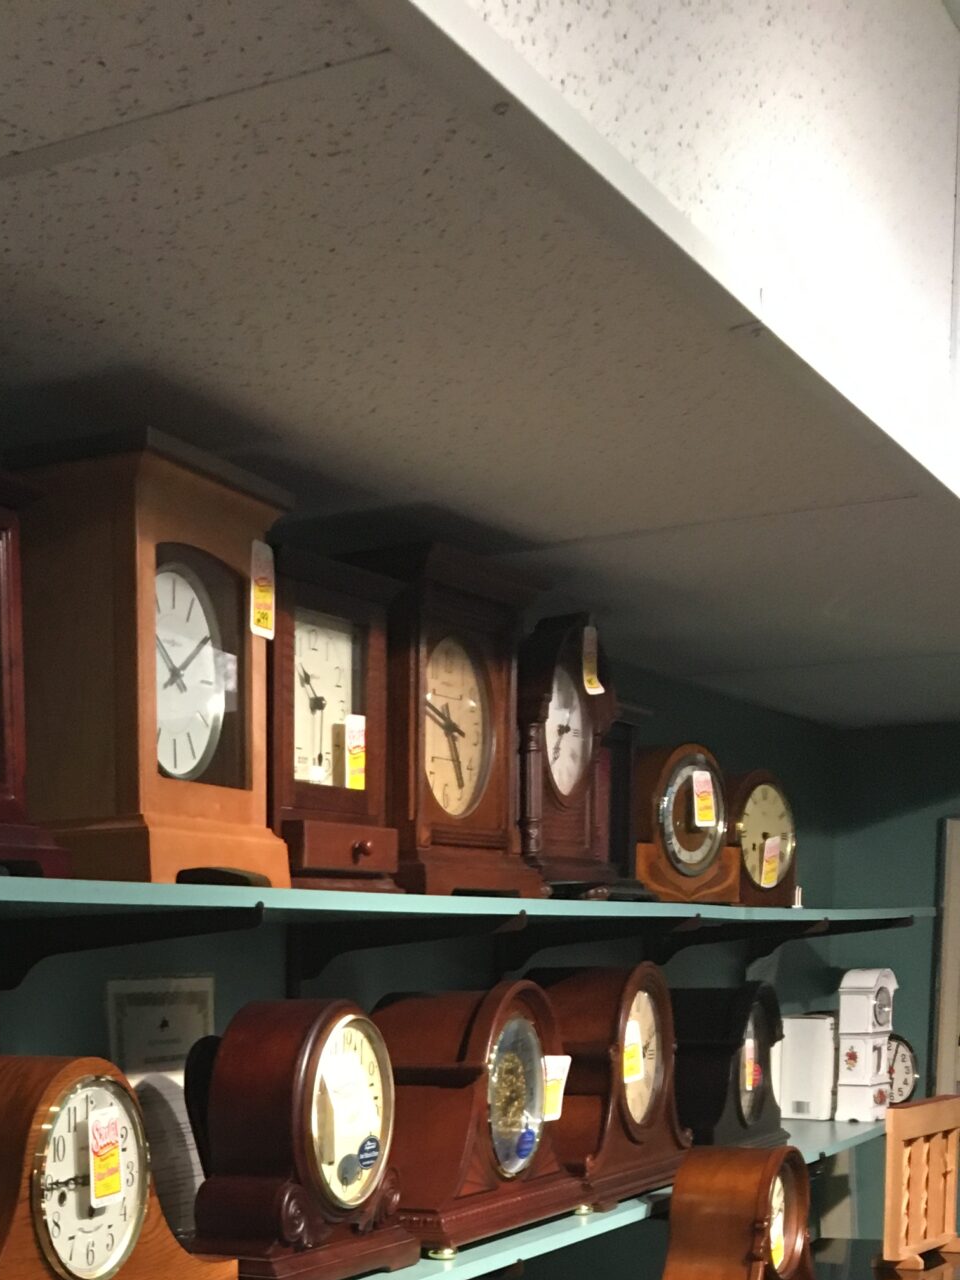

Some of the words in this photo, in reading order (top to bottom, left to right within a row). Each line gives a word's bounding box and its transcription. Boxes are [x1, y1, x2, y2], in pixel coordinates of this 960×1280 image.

[466, 758, 474, 782] 4
[442, 783, 449, 809] 6
[67, 1105, 78, 1134] 11
[52, 1134, 66, 1164] 10
[120, 1126, 129, 1153] 2
[126, 1160, 135, 1188] 3
[119, 1196, 128, 1222] 4
[51, 1210, 62, 1240] 8
[106, 1223, 115, 1251] 5
[68, 1234, 77, 1262] 7
[85, 1240, 96, 1267] 6
